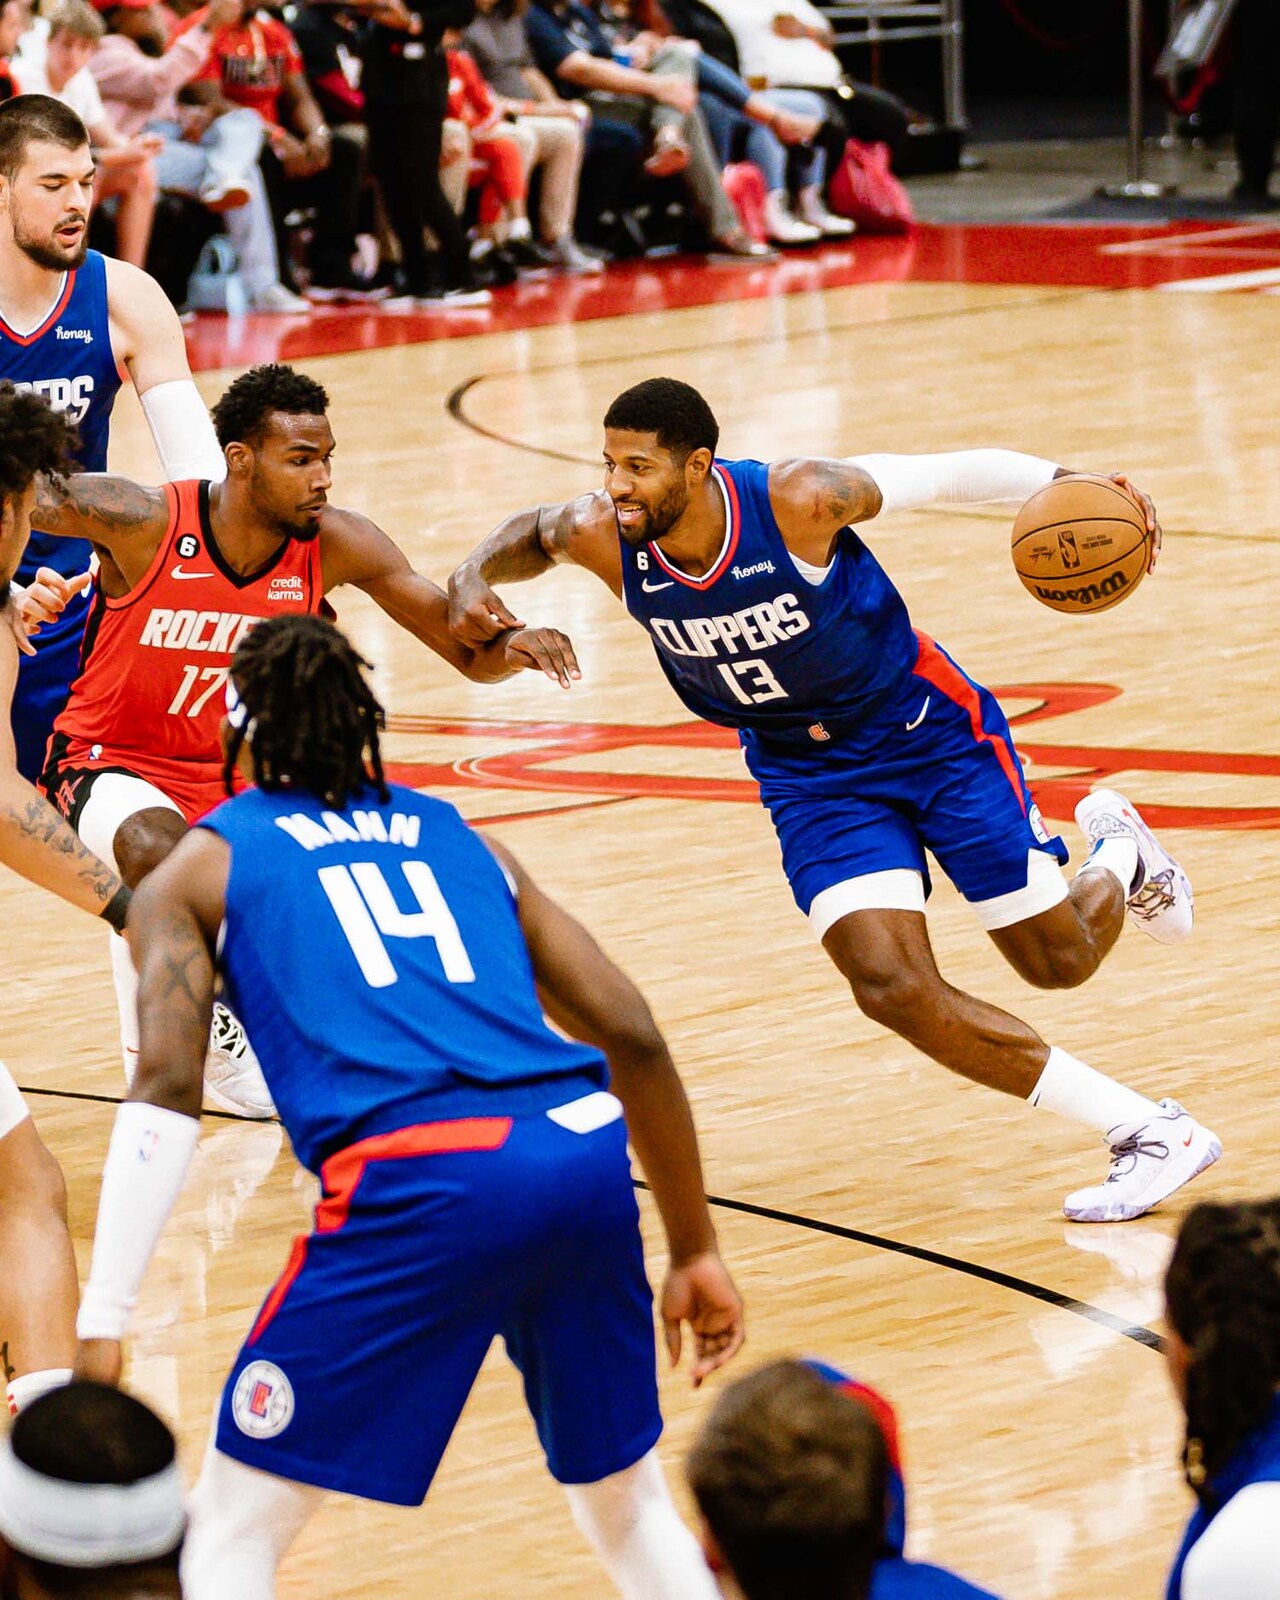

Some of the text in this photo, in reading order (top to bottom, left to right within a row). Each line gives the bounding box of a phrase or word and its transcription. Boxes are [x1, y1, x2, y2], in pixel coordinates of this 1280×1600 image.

[55, 325, 93, 343] honey
[179, 536, 197, 557] 6
[636, 551, 649, 570] 6
[271, 576, 302, 588] credit
[731, 560, 776, 580] honey
[267, 589, 303, 600] karma
[139, 608, 272, 653] ROCKE
[650, 593, 810, 657] CLIPPERS
[167, 665, 231, 717] 17
[717, 658, 789, 704] 13
[274, 810, 421, 851] MANN
[317, 860, 476, 988] 14
